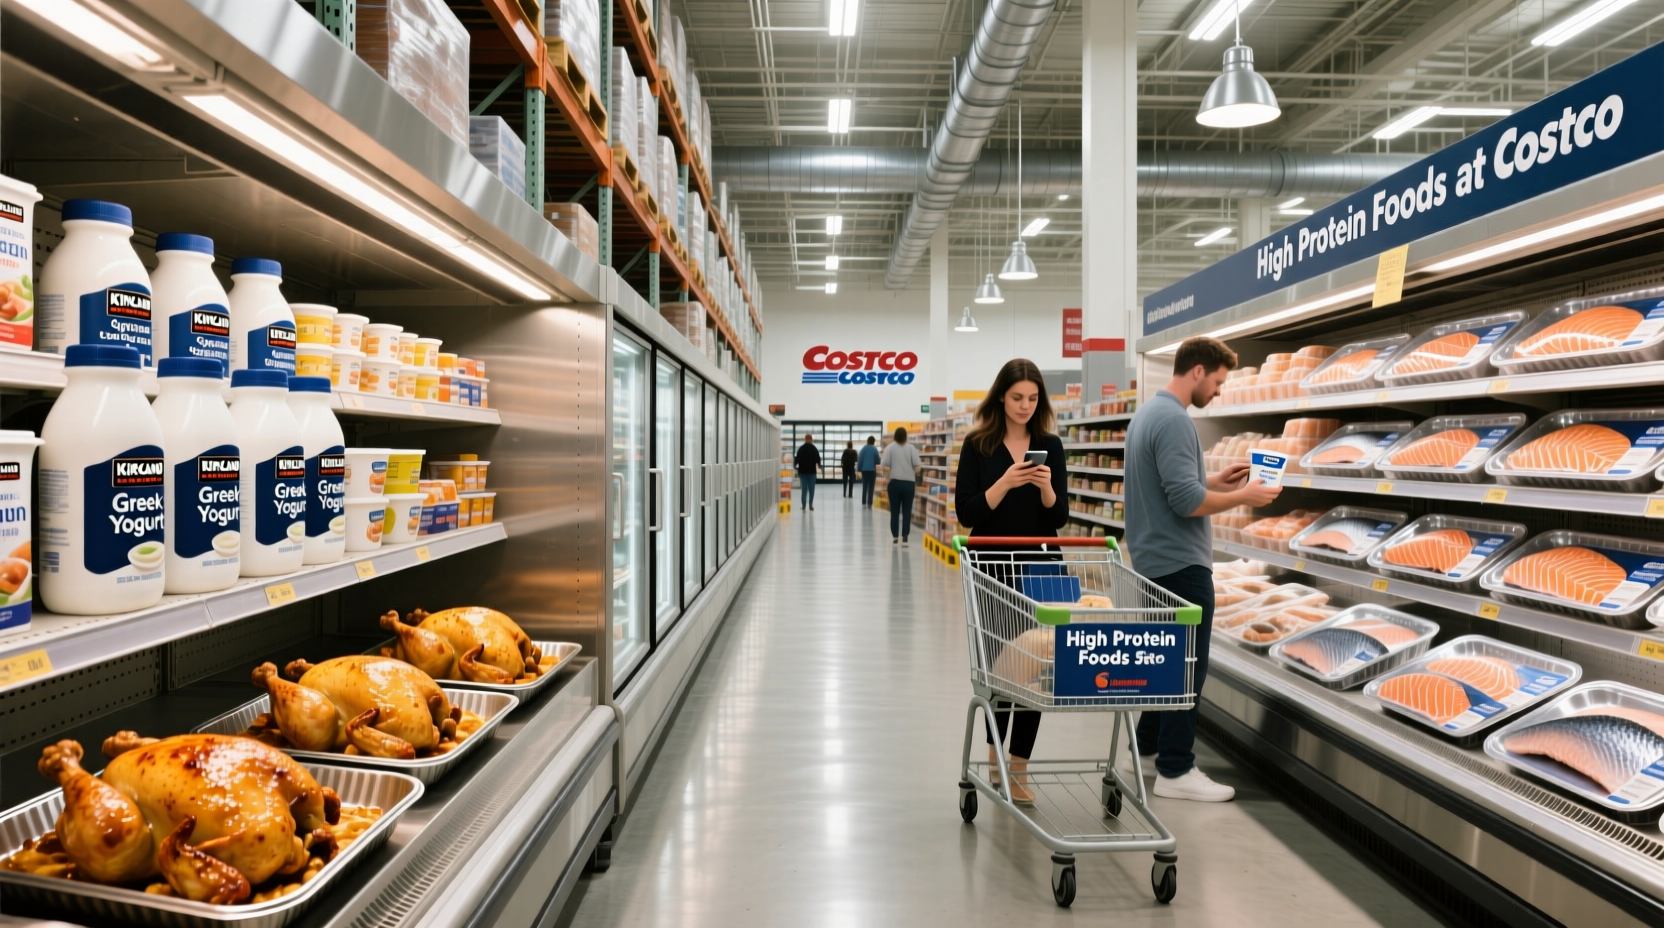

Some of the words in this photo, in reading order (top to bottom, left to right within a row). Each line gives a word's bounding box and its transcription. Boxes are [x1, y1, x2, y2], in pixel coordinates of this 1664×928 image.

[1256, 235, 1294, 281] High
[1298, 205, 1366, 261] Protein
[1372, 165, 1447, 231] Foods
[1455, 147, 1486, 197] at
[1493, 94, 1624, 179] Costco
[112, 492, 164, 513] Greek
[1066, 630, 1108, 650] High
[1112, 630, 1176, 647] Protein
[1078, 649, 1130, 665] Foods
